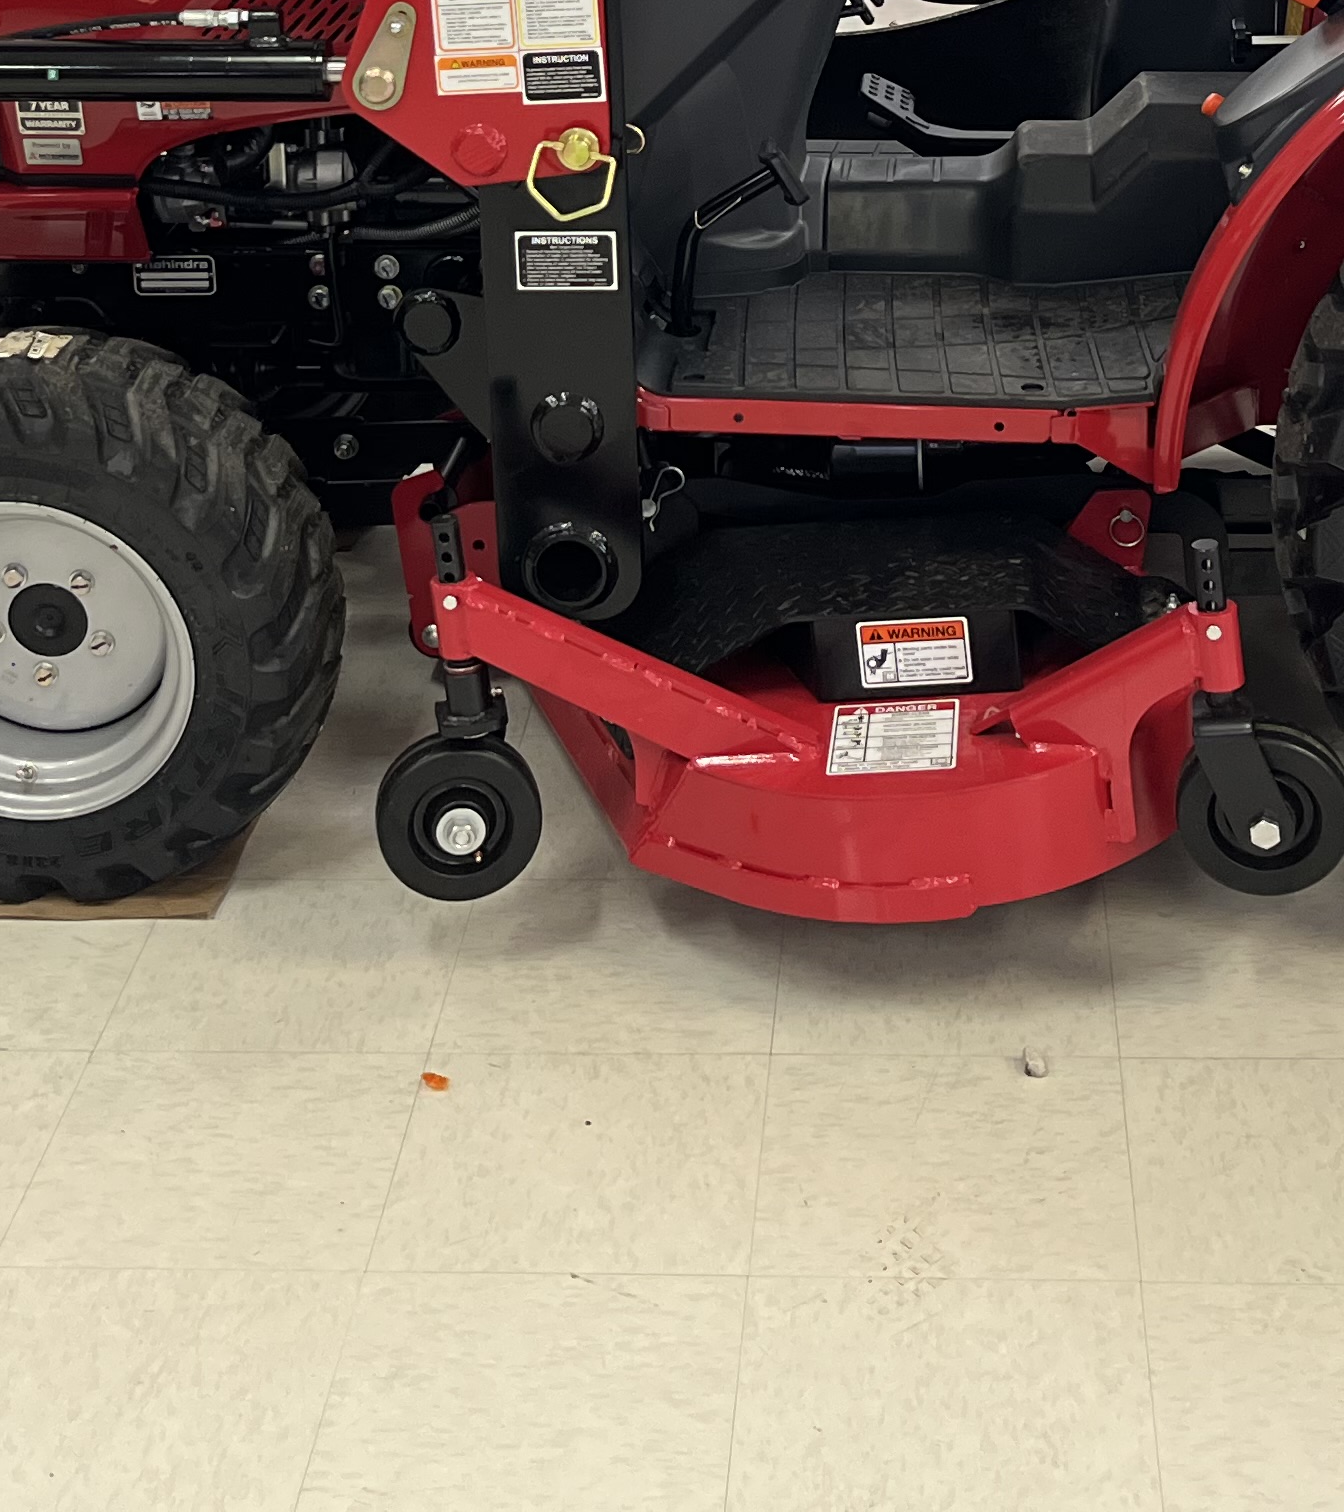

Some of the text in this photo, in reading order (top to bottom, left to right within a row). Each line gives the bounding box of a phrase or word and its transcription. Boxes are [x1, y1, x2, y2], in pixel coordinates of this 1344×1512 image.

[460, 58, 506, 68] WARNING
[532, 53, 589, 64] INSTRUCTION
[38, 101, 69, 111] YEAR
[24, 119, 77, 129] WARRANTY
[531, 236, 599, 245] INSTRUCTIONS
[886, 625, 957, 640] WARNING
[875, 703, 938, 714] DANGER
